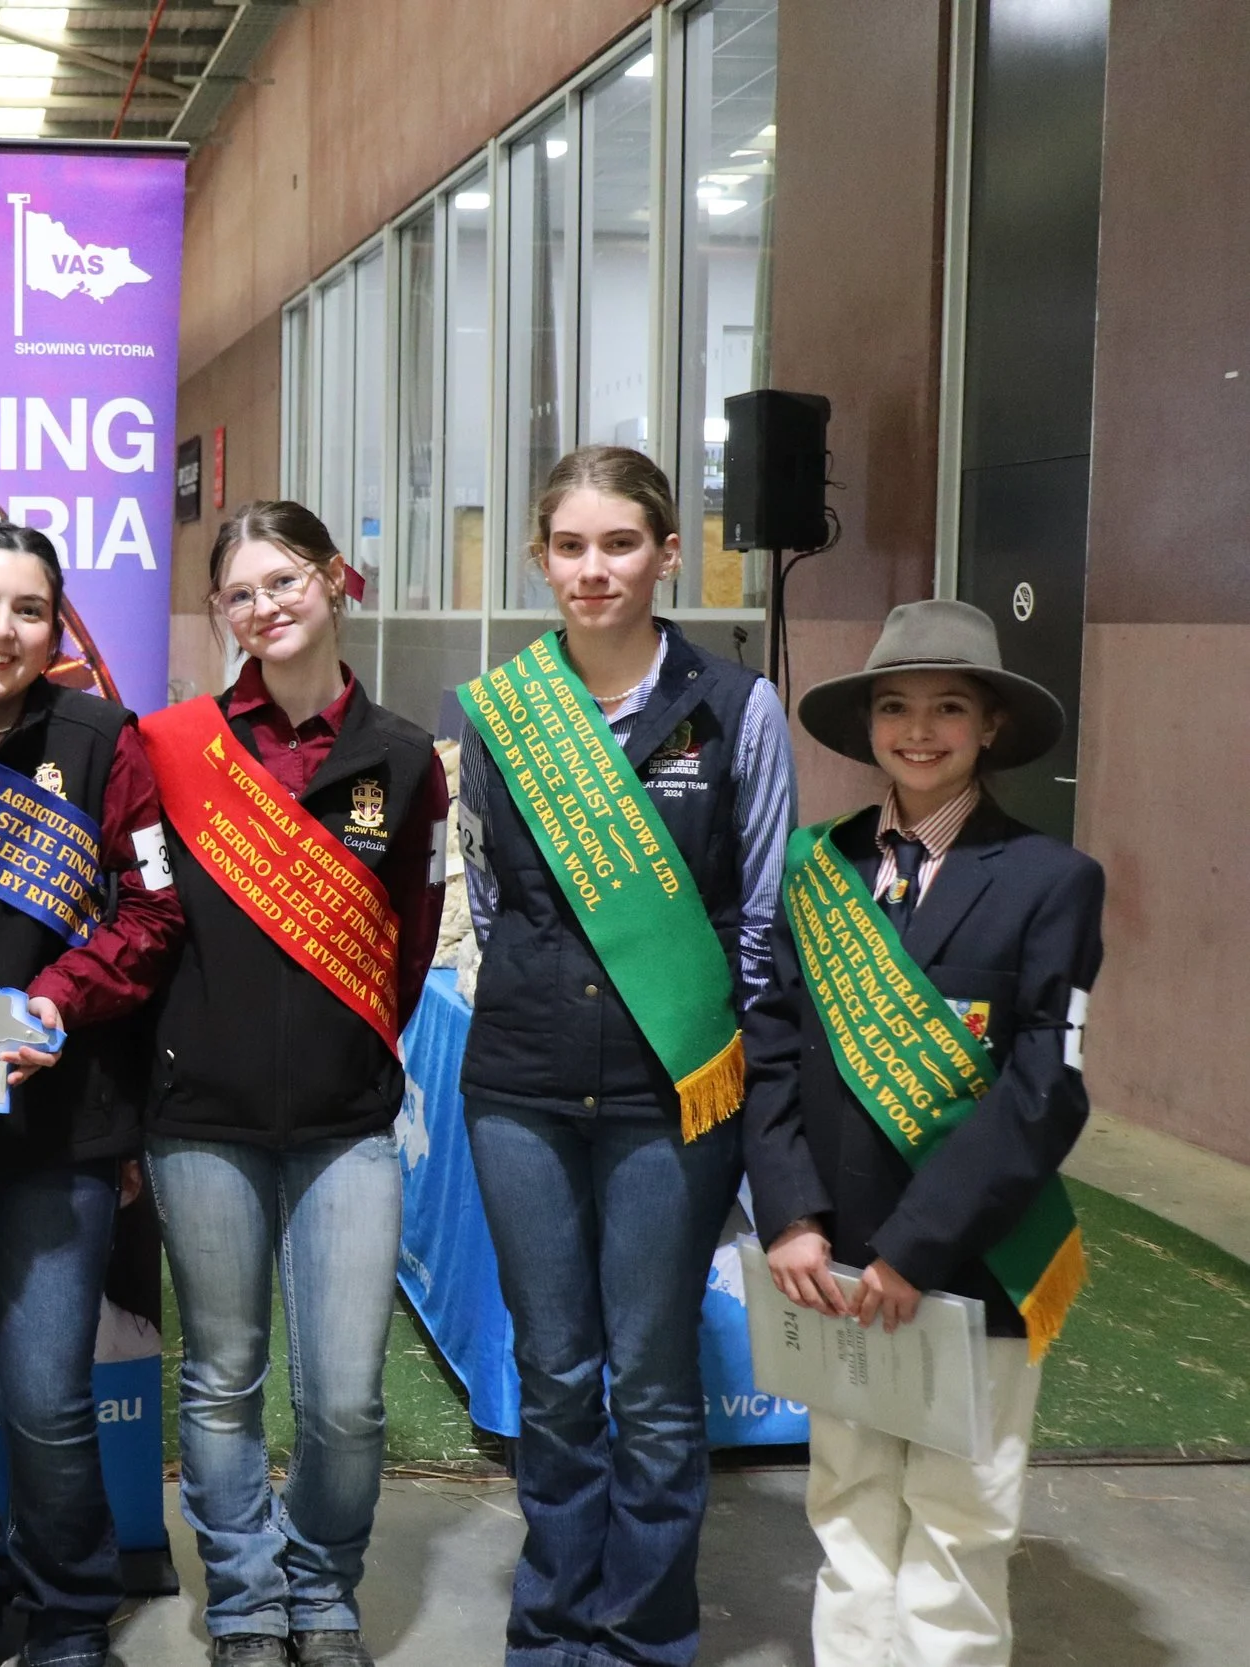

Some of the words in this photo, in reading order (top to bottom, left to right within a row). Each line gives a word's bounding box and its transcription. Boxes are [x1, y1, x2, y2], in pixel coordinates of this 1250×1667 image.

[52, 254, 105, 276] VAS
[14, 342, 86, 356] SHOWING
[88, 343, 155, 358] VICTORIA
[523, 680, 566, 739] STATE
[555, 736, 614, 818] FINALIST
[548, 676, 624, 795] AGRICULTURAL
[616, 795, 661, 856] SHOWS
[651, 857, 679, 899] LTD.
[655, 780, 686, 789] JUDGING
[687, 781, 708, 790] TEAM
[663, 789, 682, 797] 2024
[227, 761, 302, 839] VICTORIAN
[297, 835, 386, 926] AGRICULTURAL
[343, 834, 387, 852] Captain
[344, 825, 368, 835] SHOW
[369, 828, 388, 838] TEAM
[464, 828, 476, 859] 2
[505, 744, 526, 770] BY
[516, 768, 571, 855] RIVERINA
[564, 851, 602, 912] WOOL
[519, 721, 566, 792] FLEECE
[556, 792, 615, 878] JUDGING
[56, 844, 97, 887] FINAL
[158, 845, 171, 875] 3
[208, 811, 273, 879] MERINO
[267, 872, 334, 935] FLEECE
[329, 930, 388, 986] JUDGING
[289, 859, 347, 913] STATE
[342, 905, 380, 948] FINAL
[196, 829, 284, 921] SPONSORED
[278, 916, 306, 943] BY
[301, 939, 368, 1001] RIVERINA
[369, 991, 391, 1029] WOOL
[798, 884, 832, 955] MERINO
[826, 954, 867, 1024] FLEECE
[858, 1023, 933, 1110] JUDGING
[826, 907, 867, 968] STATE
[856, 964, 922, 1047] FINALIST
[844, 897, 929, 1019] AGRICULTURAL
[923, 1017, 977, 1078] SHOWS
[816, 978, 834, 1004] BY
[827, 1001, 880, 1090] RIVERINA
[876, 1085, 923, 1146] WOOL
[782, 1310, 800, 1351] 2024
[97, 1397, 142, 1424] au
